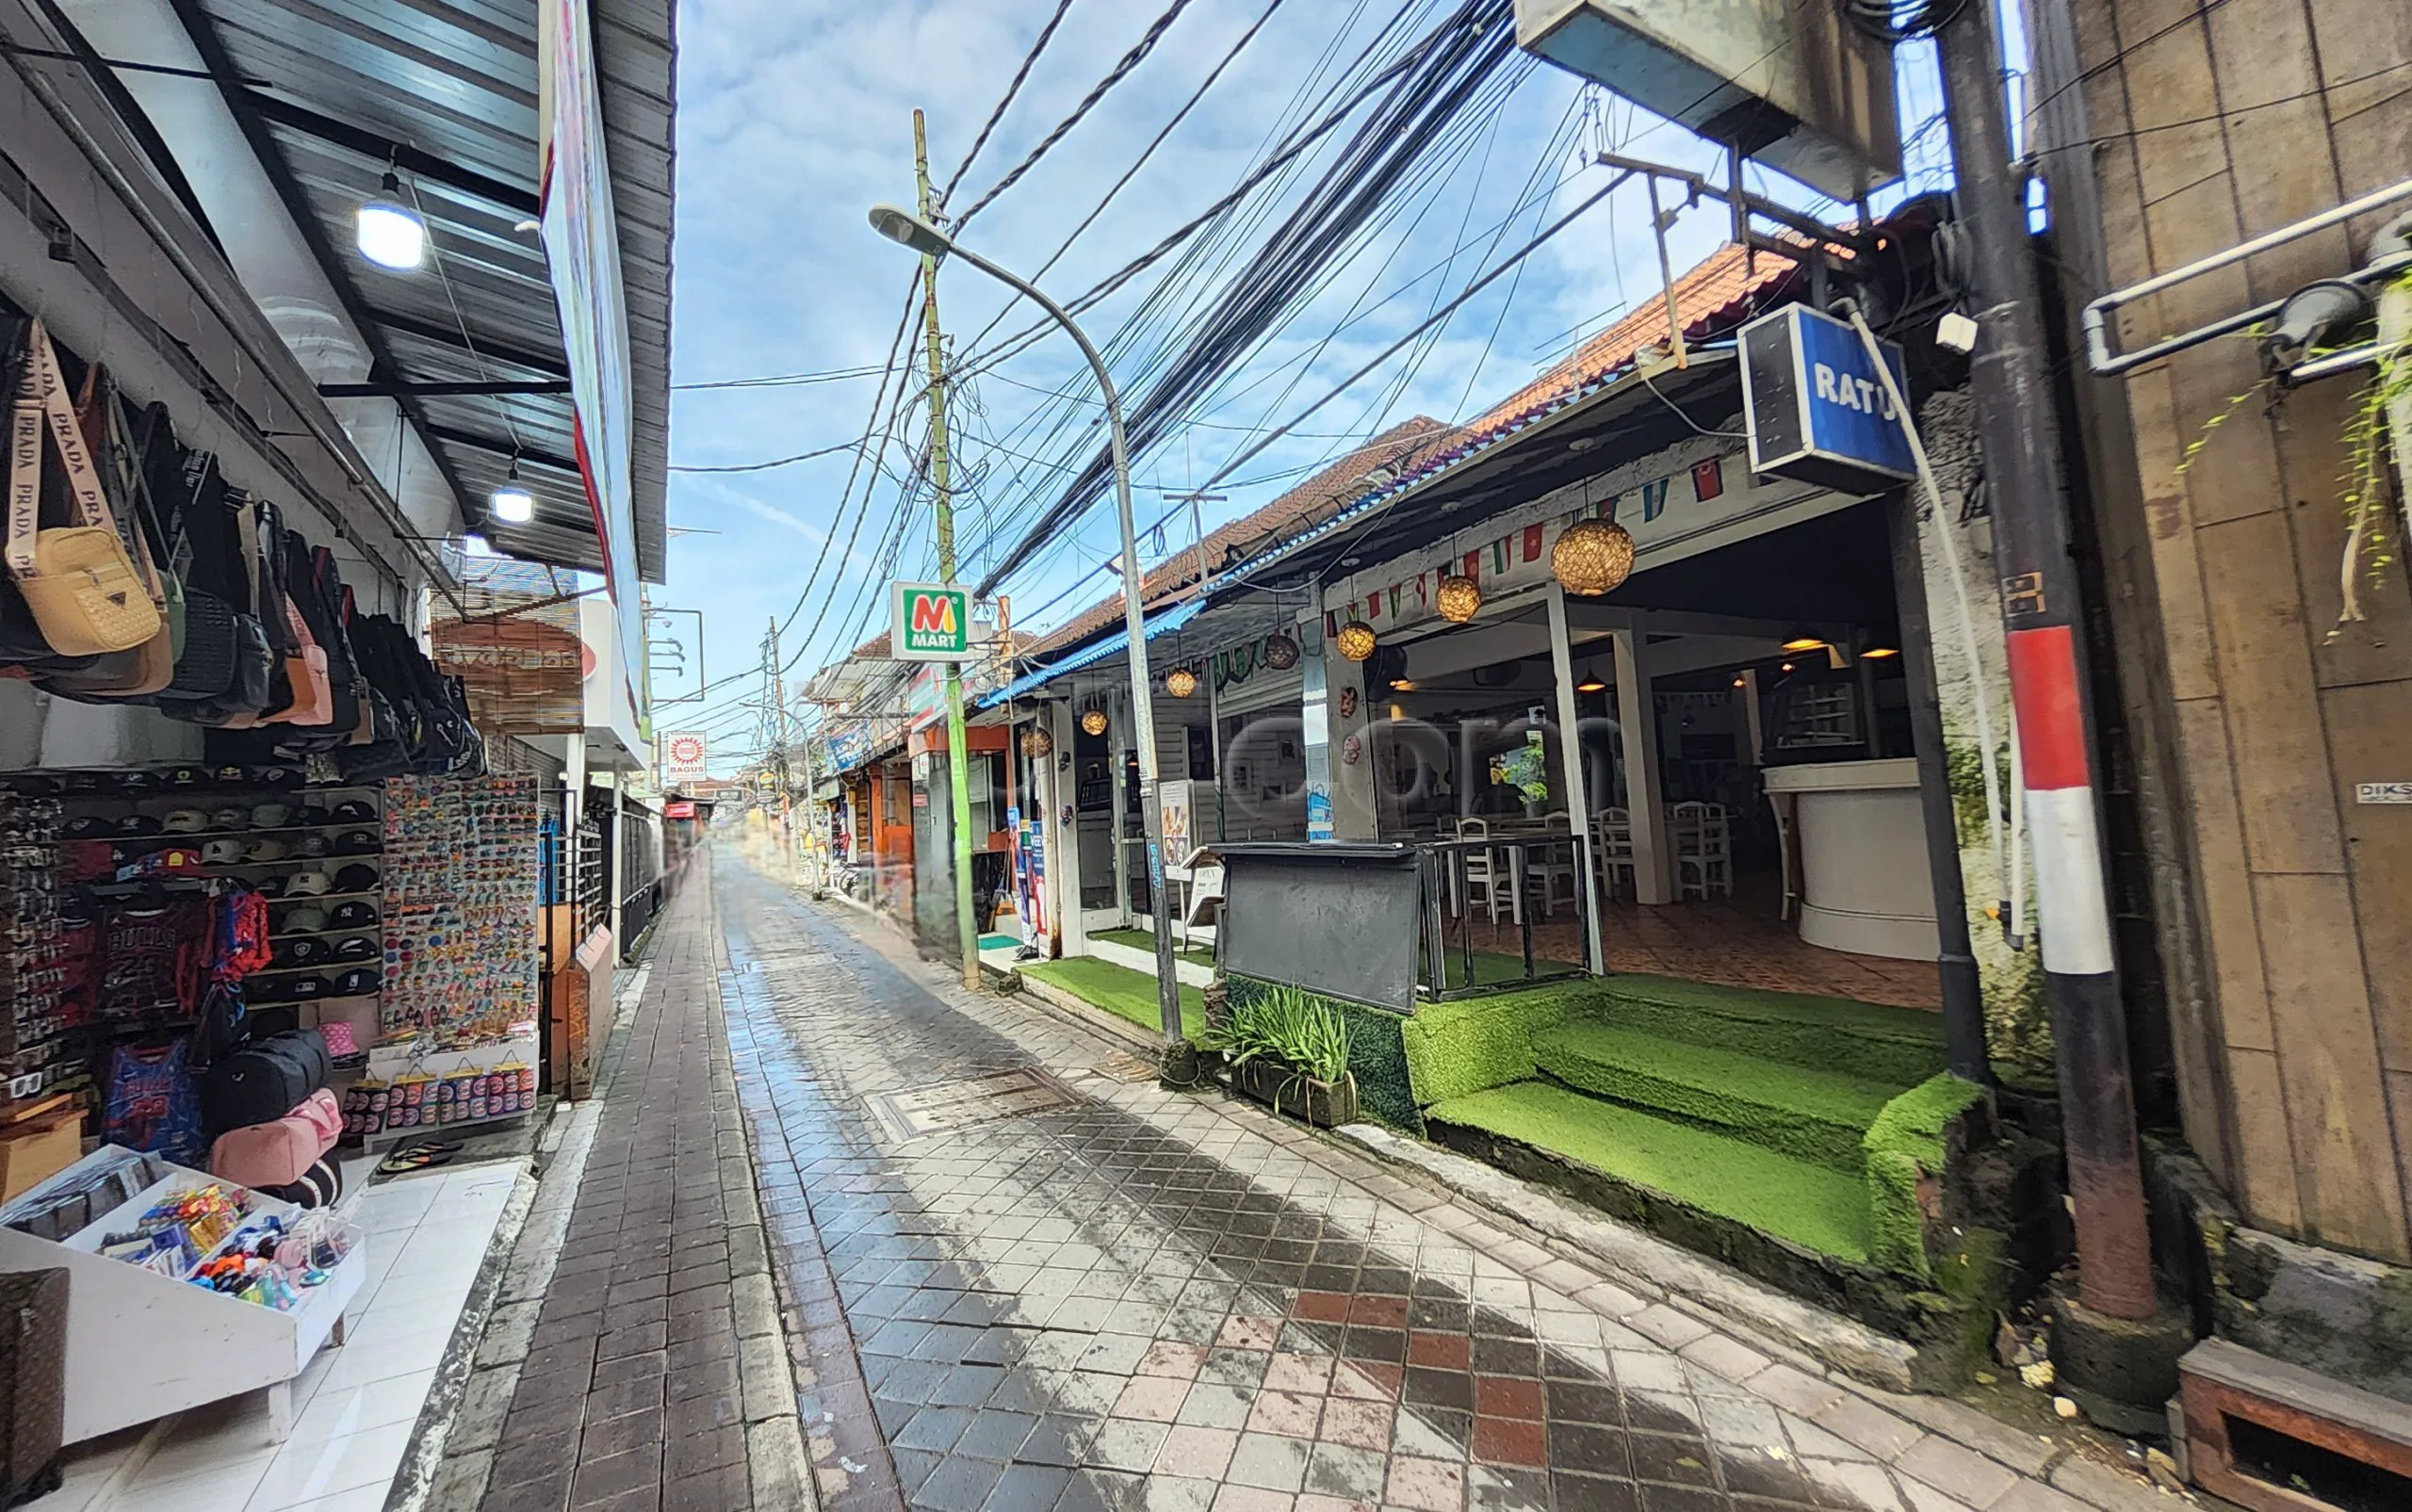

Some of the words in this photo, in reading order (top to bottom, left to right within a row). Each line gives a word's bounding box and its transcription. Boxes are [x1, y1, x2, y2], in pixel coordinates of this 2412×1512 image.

[1814, 362, 1900, 421] RATU
[18, 416, 36, 469] PRADA
[53, 413, 86, 475] PRADA
[14, 484, 34, 540] PRADA
[80, 490, 104, 528] PRA
[911, 634, 957, 648] MART
